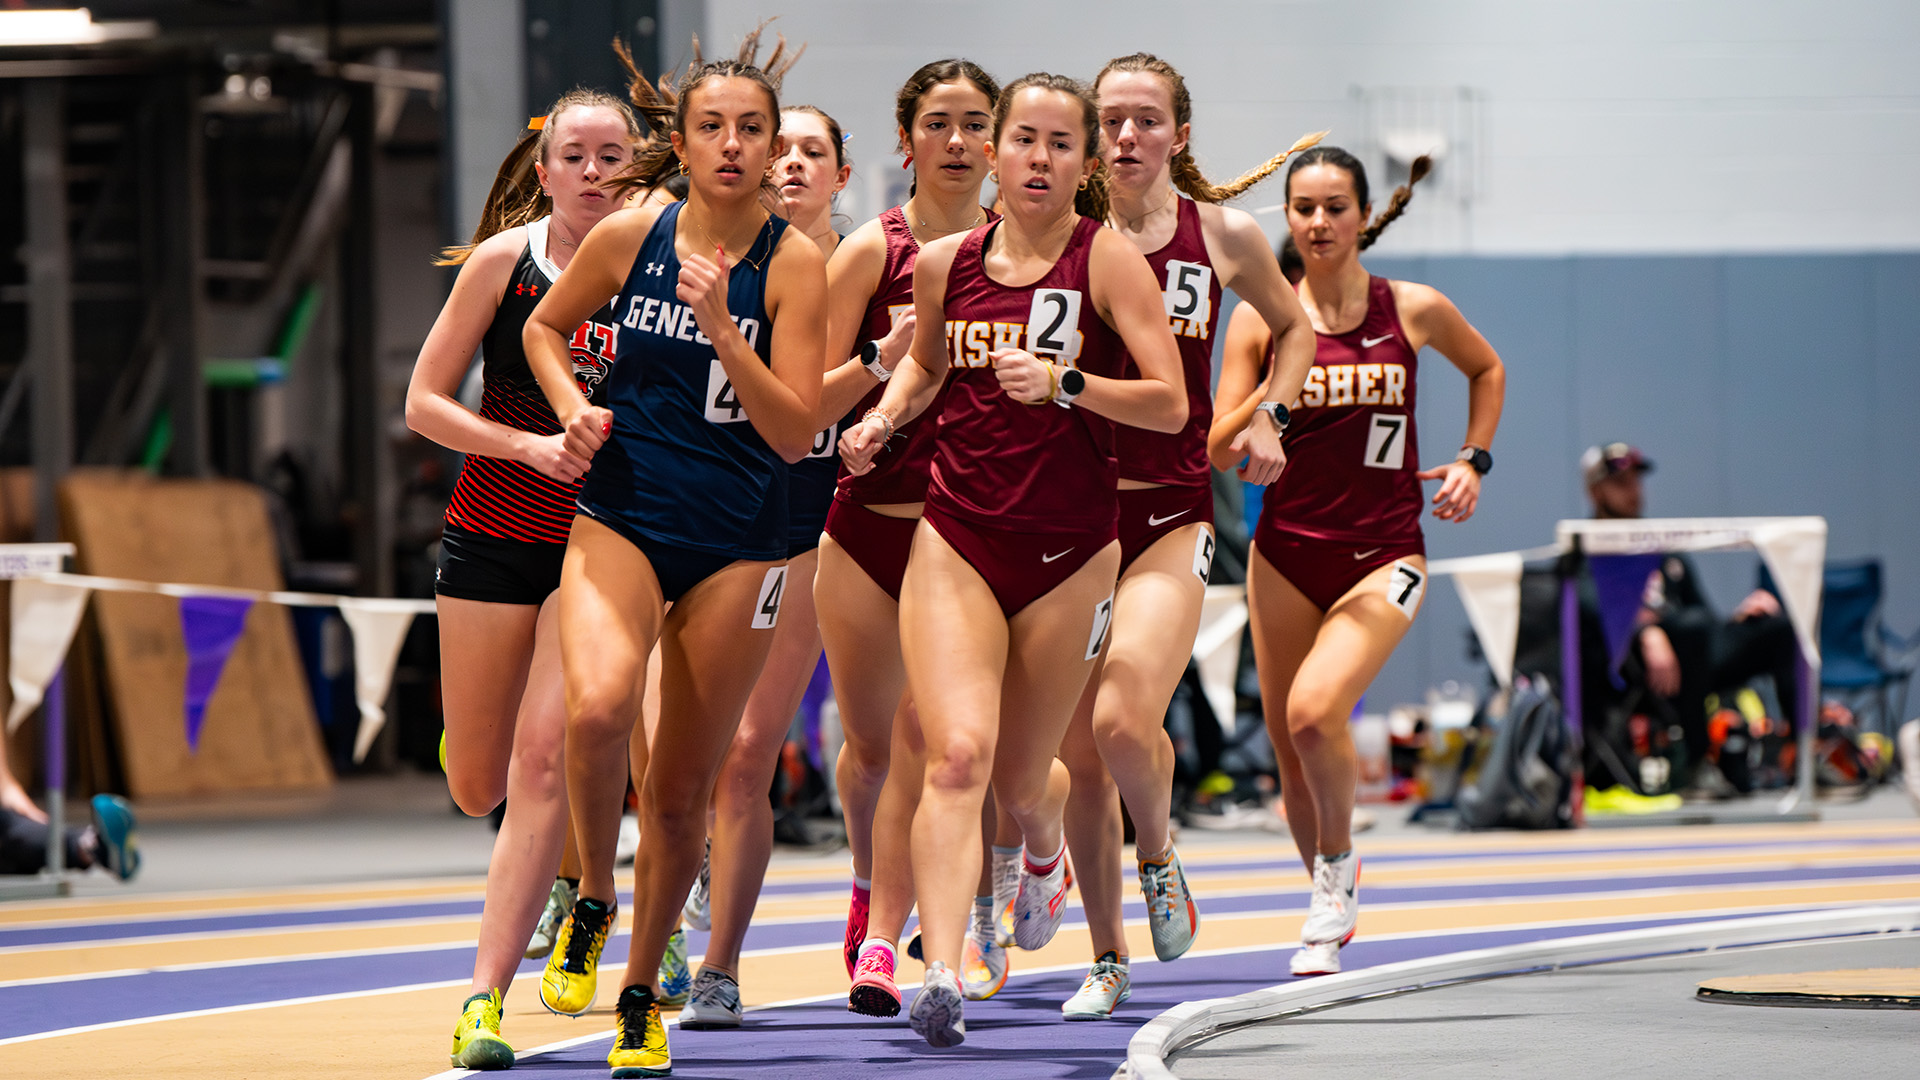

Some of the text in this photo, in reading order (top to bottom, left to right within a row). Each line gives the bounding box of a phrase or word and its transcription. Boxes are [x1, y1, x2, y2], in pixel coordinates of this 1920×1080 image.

[1174, 266, 1201, 315] 5
[569, 320, 616, 364] IT
[623, 295, 759, 351] GENEO
[1036, 292, 1068, 351] 2
[714, 378, 742, 419] 4
[1292, 363, 1407, 410] SHER
[1375, 419, 1401, 463] 7
[1199, 534, 1214, 583] 5
[760, 570, 784, 625] 4
[1397, 566, 1422, 606] 7
